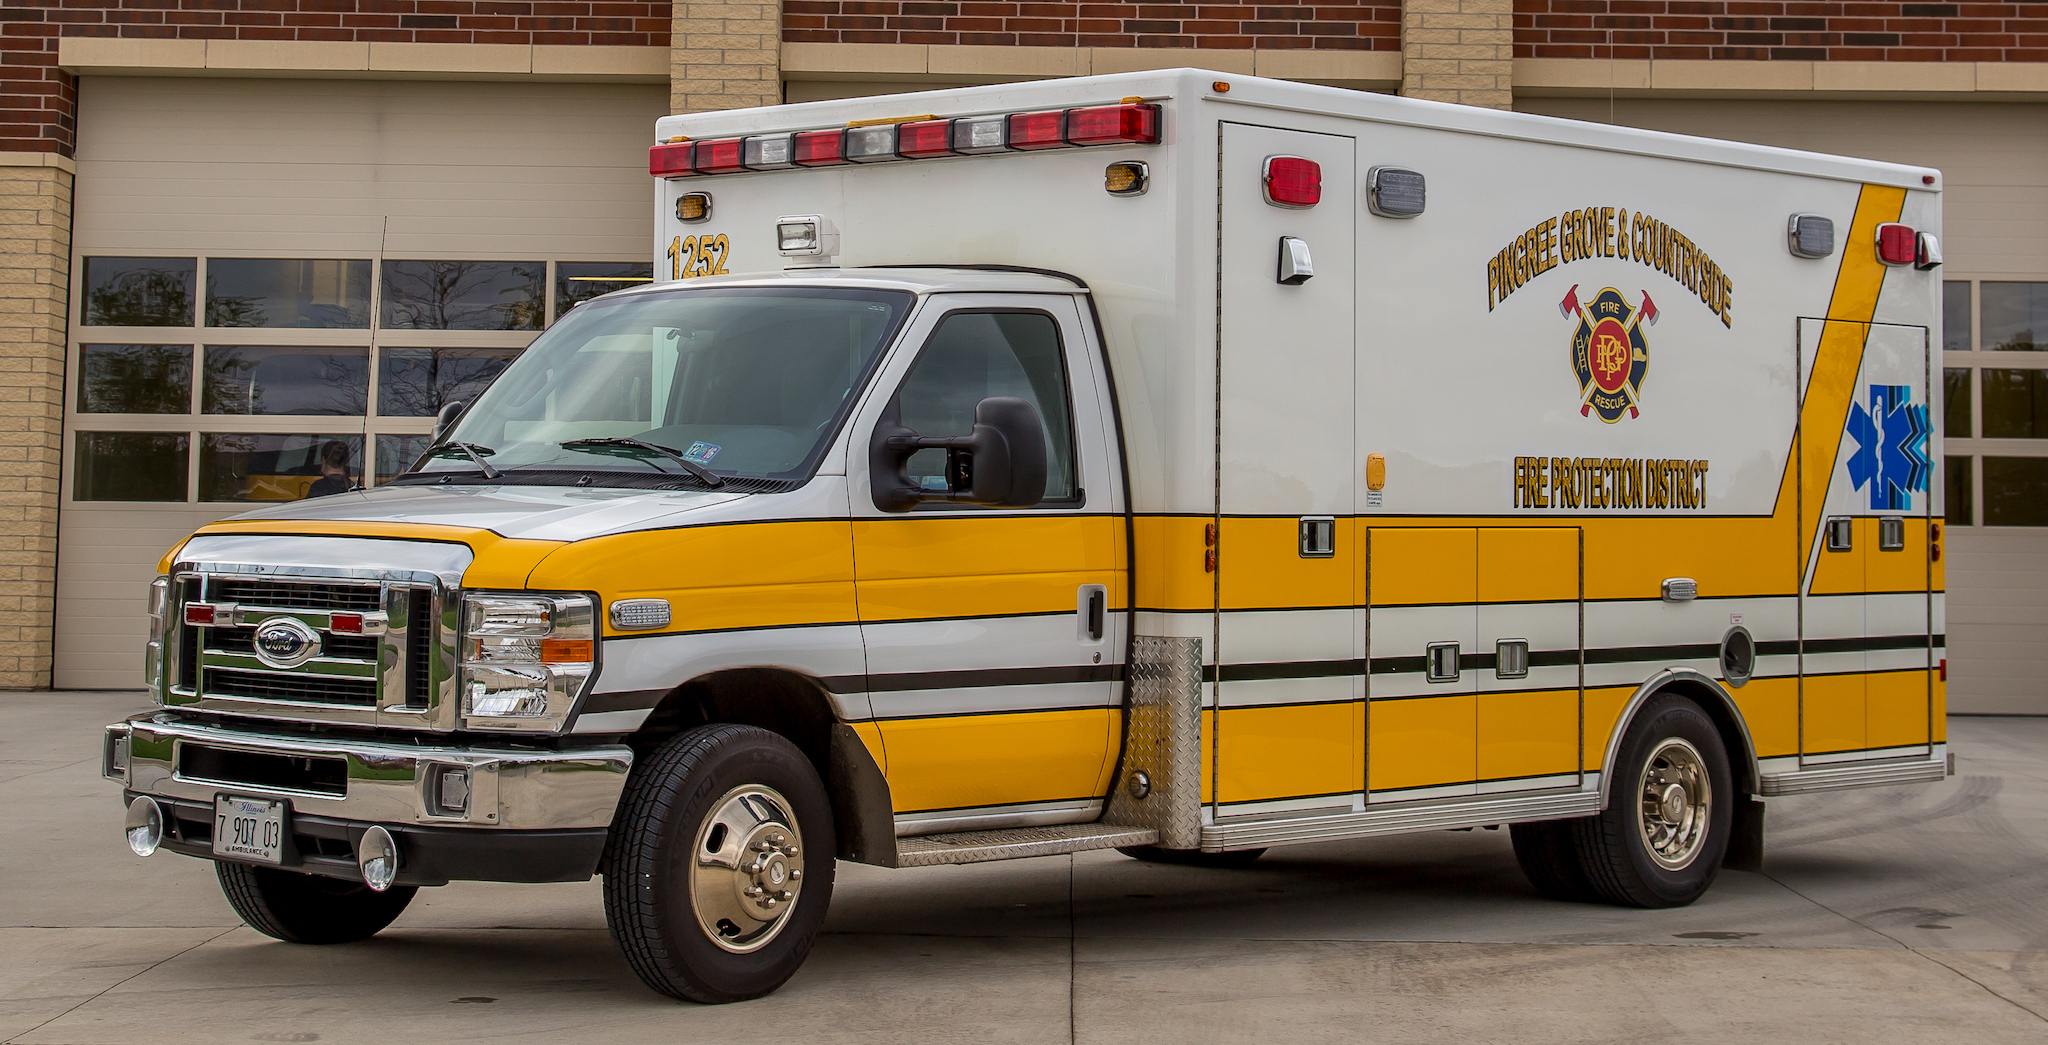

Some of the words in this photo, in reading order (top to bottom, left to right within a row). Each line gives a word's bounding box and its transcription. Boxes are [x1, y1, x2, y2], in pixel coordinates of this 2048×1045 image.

[667, 233, 729, 280] 1252
[1487, 216, 1558, 313] PINGREE
[1561, 207, 1615, 264] GROVE
[1618, 207, 1630, 262] &
[1632, 211, 1732, 330] COUNTRYSIDE
[1600, 301, 1620, 314] FIRE
[1594, 394, 1626, 410] RESCUE
[1514, 456, 1549, 509] FIRE
[1551, 456, 1643, 509] PROTECTION
[1646, 458, 1709, 509] DISTRICT
[260, 630, 293, 651] Ford
[234, 801, 267, 814] Illinois
[218, 814, 226, 842] 7
[233, 816, 257, 846] 907
[263, 820, 279, 849] 03
[232, 845, 263, 856] AMBULANCE
